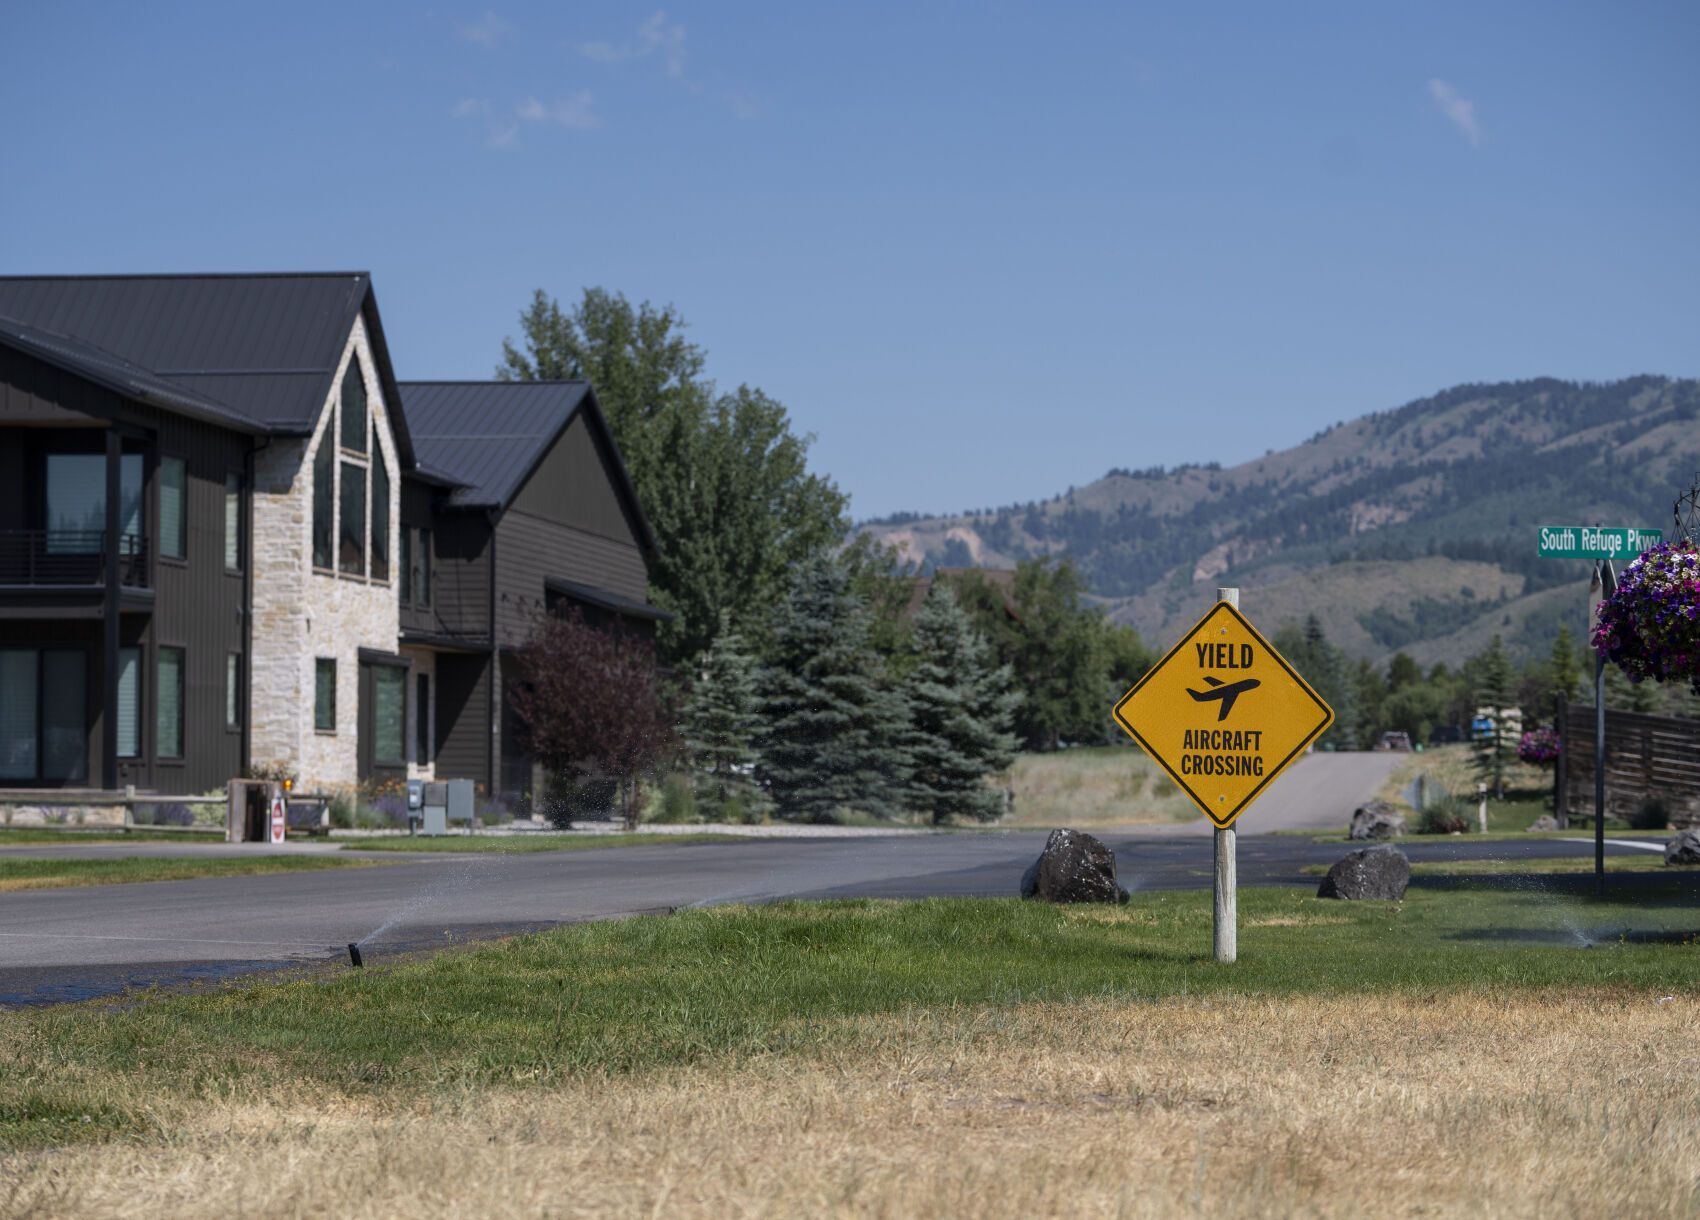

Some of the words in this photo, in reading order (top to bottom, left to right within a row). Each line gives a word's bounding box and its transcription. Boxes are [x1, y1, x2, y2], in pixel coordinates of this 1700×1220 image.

[1541, 528, 1575, 551] South
[1582, 529, 1622, 558] Refuge
[1196, 643, 1254, 669] YIELD
[1183, 729, 1263, 751] AIRCRAFT
[1181, 755, 1264, 777] CROSSING
